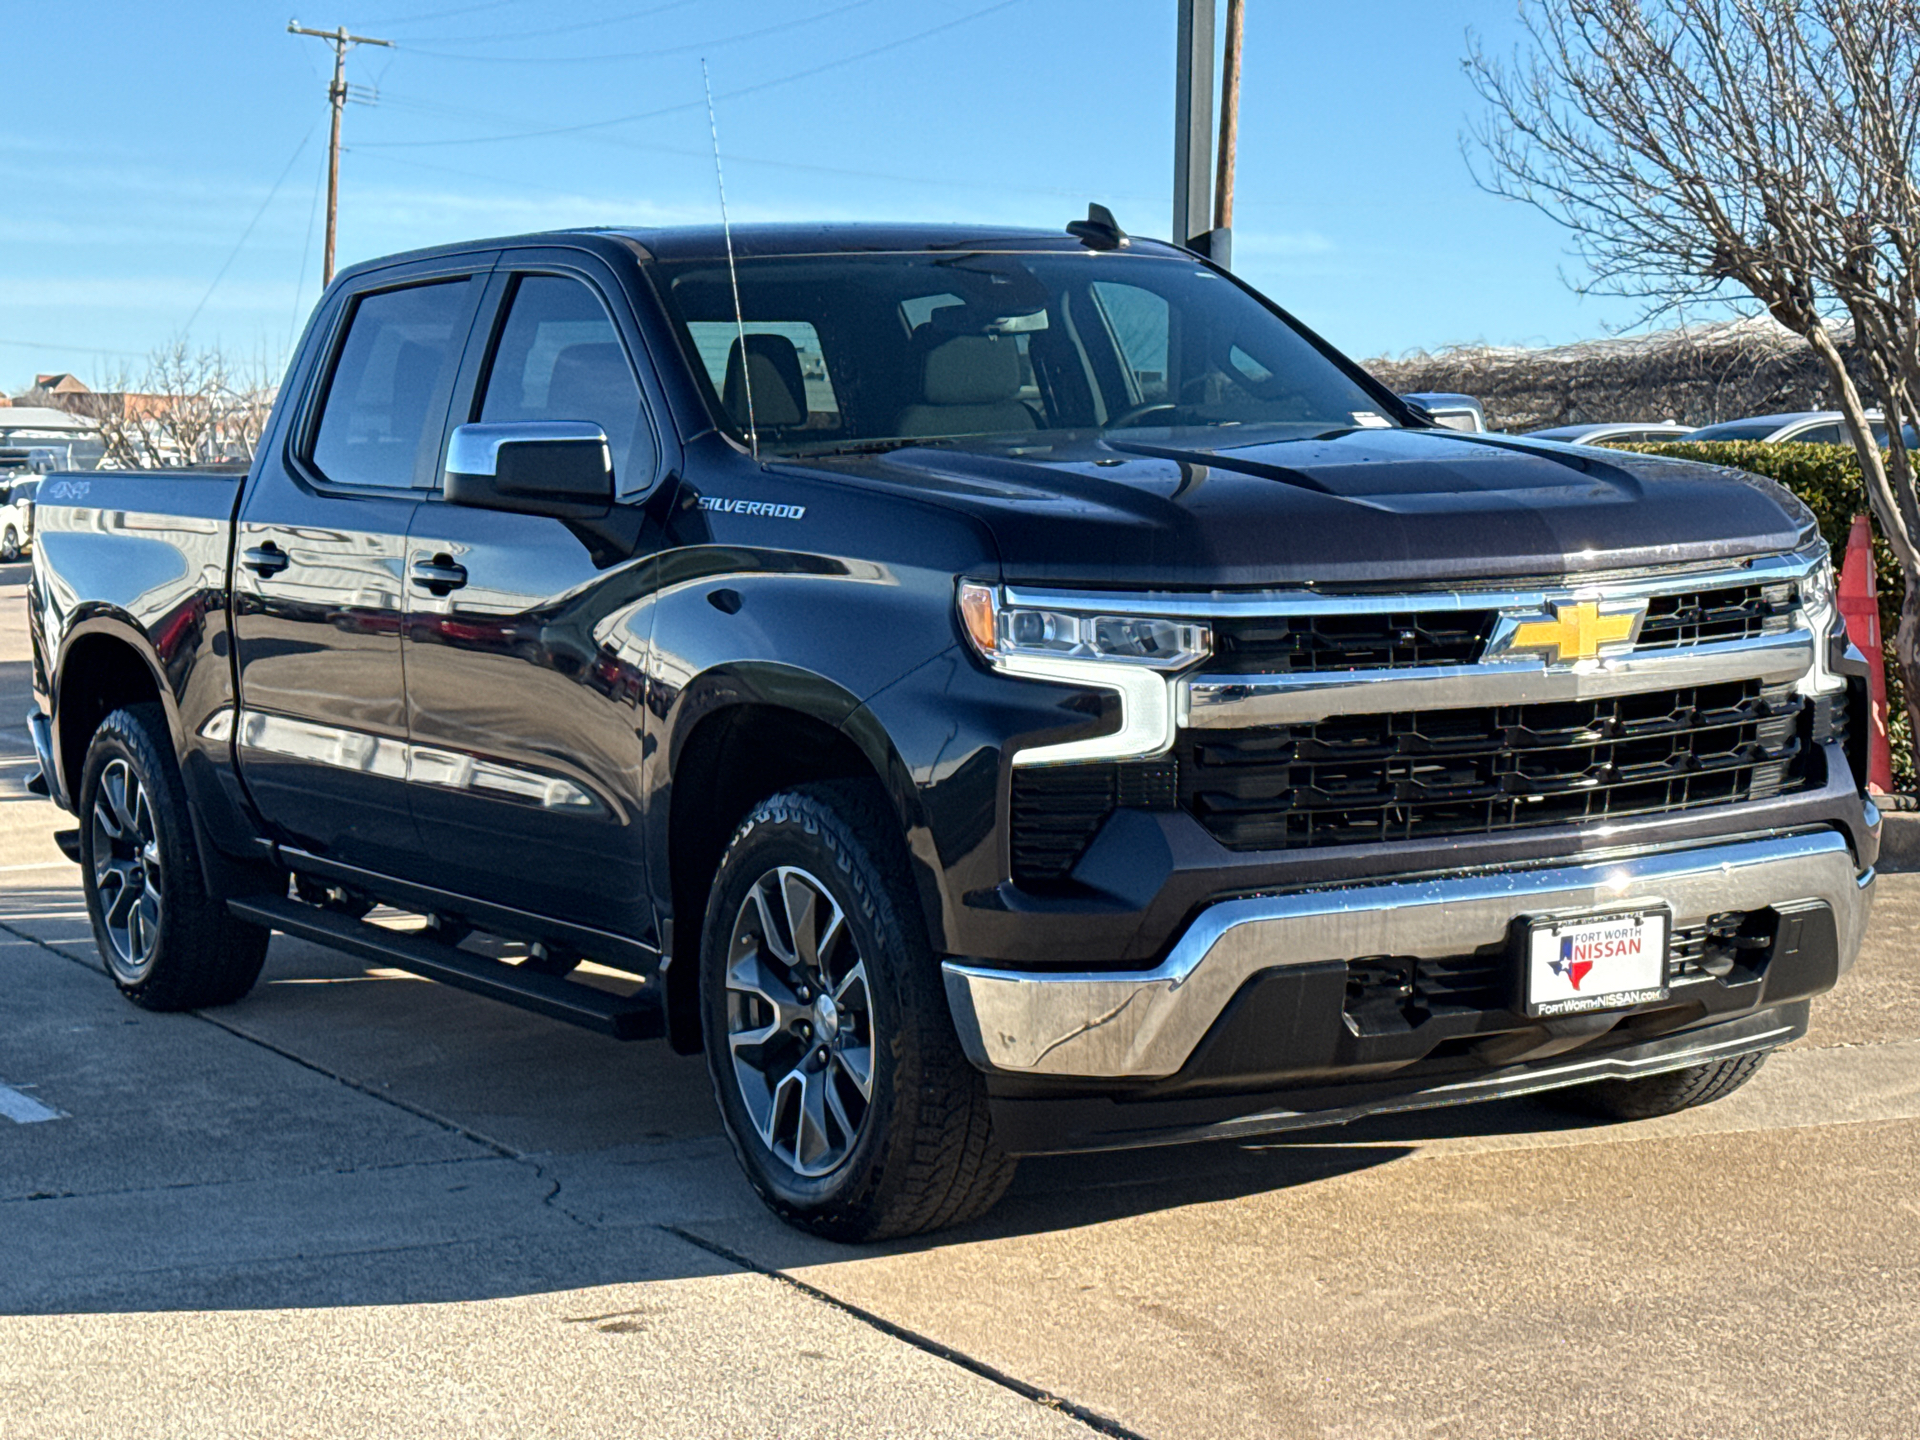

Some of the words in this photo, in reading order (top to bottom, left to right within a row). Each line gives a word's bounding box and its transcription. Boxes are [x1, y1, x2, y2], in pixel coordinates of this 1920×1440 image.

[697, 496, 806, 519] SILVERADO
[1575, 932, 1602, 943] FORT
[1604, 928, 1642, 939] WORTH
[1574, 938, 1641, 960] NISSAN
